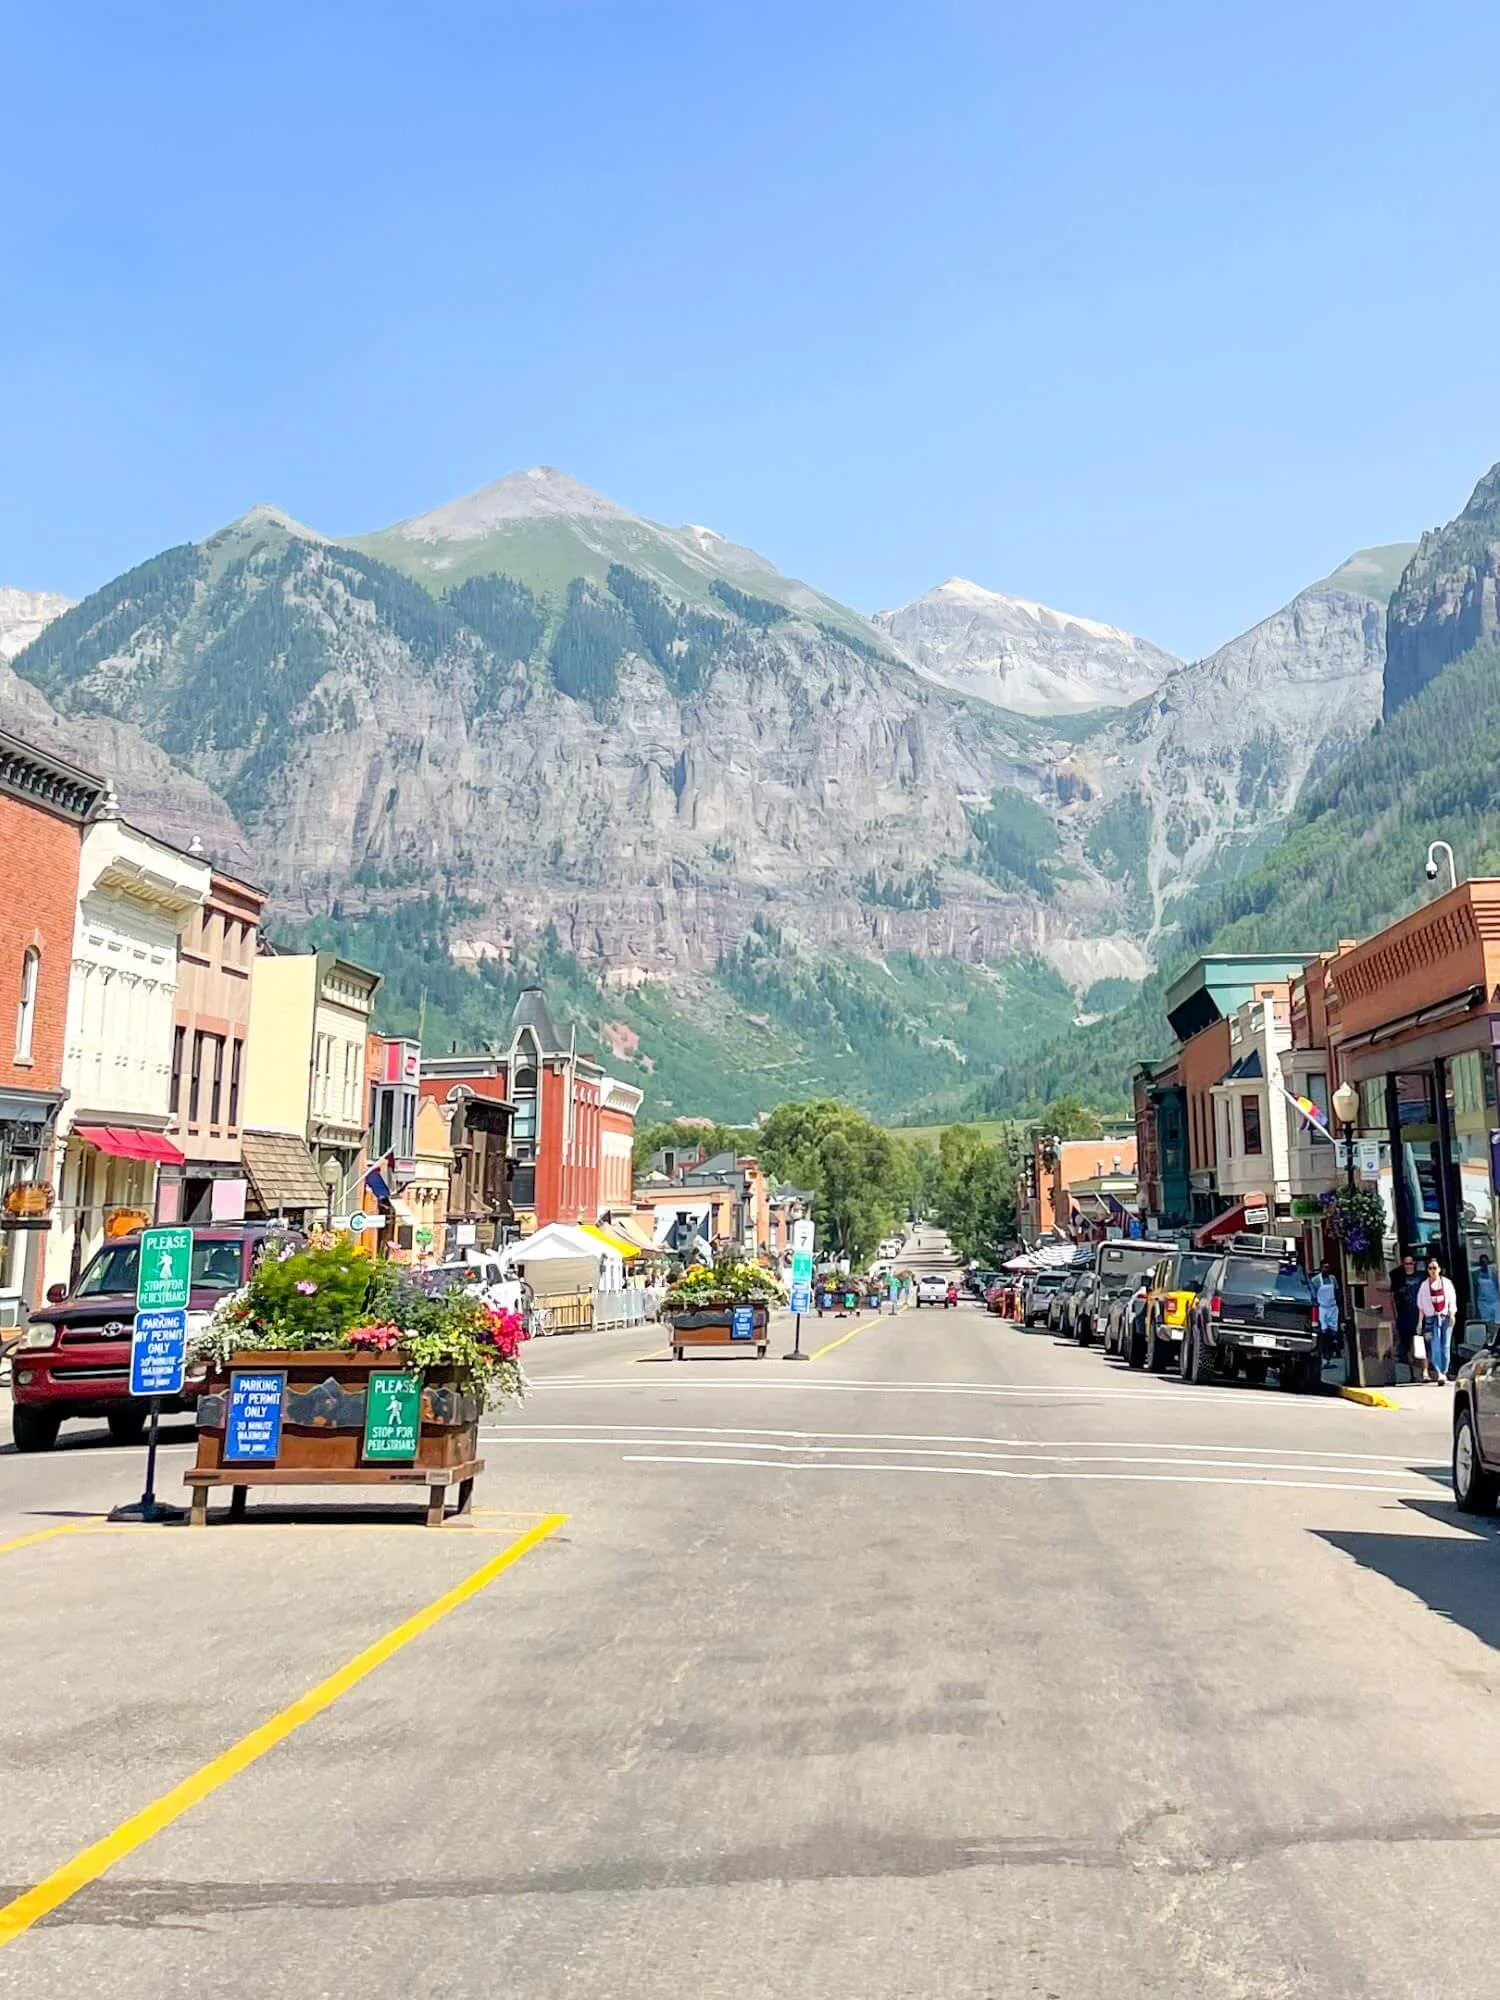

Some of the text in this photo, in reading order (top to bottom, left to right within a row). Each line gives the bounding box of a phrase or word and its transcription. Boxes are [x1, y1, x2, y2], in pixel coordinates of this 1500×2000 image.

[147, 1236, 186, 1249] PLEASE
[144, 1279, 183, 1291] STOP FOR
[142, 1318, 179, 1328] PARKING
[135, 1329, 183, 1343] BY PERMIT
[148, 1343, 170, 1354] ONLY
[240, 1380, 277, 1391] PARKING
[375, 1380, 415, 1393] PLEASE
[233, 1393, 281, 1405] BY PERMIT
[245, 1407, 267, 1417] ONLY
[236, 1421, 273, 1431] 30 MINUTE
[372, 1427, 413, 1438] STOP FOR
[368, 1439, 415, 1450] PEDESTRIANS
